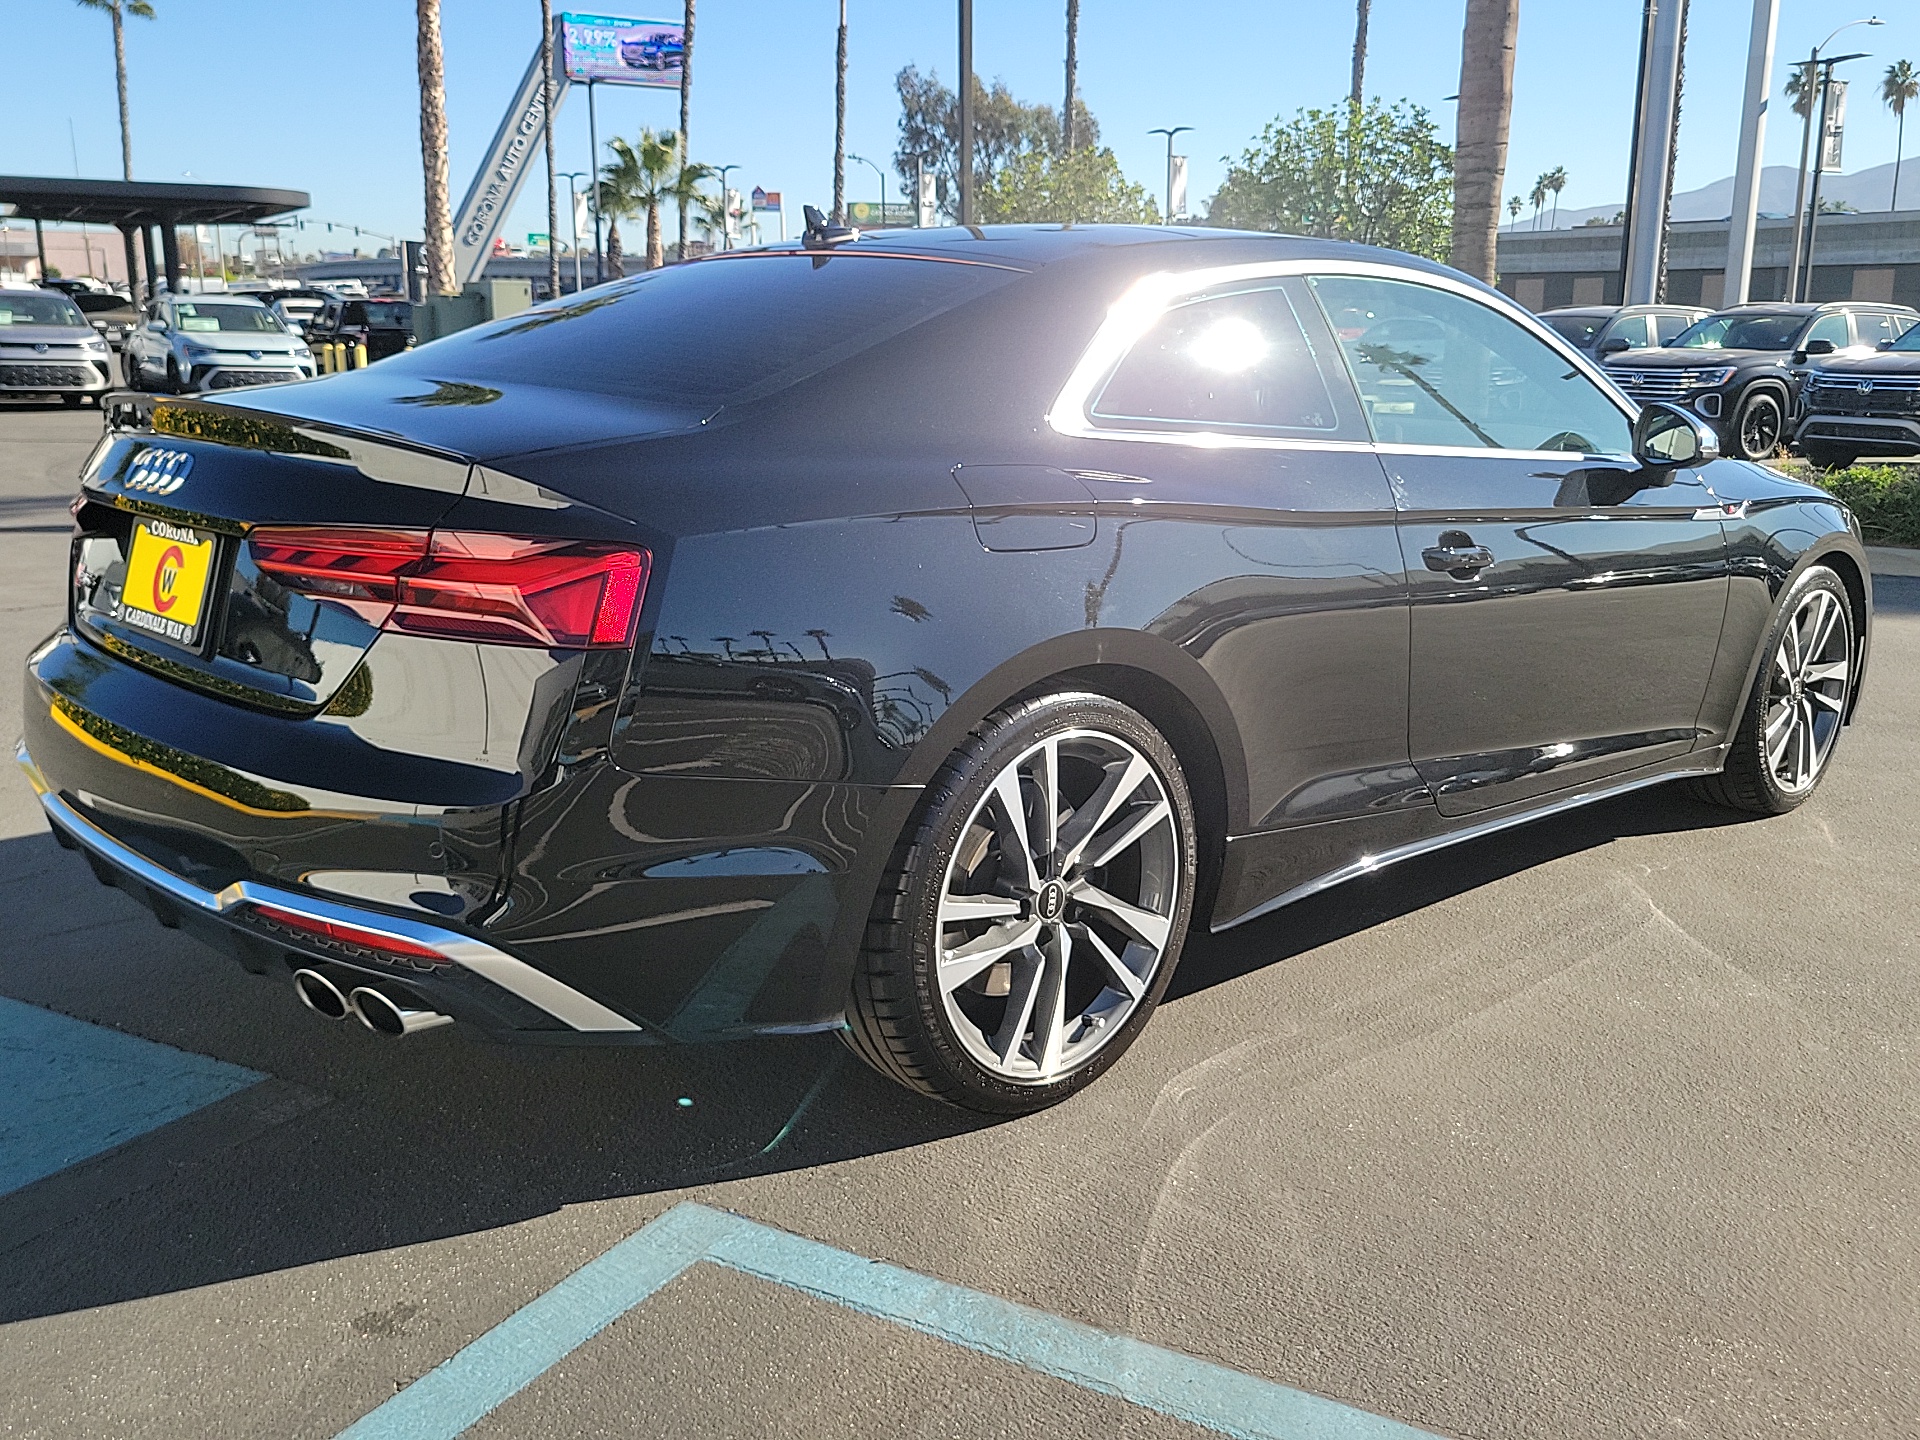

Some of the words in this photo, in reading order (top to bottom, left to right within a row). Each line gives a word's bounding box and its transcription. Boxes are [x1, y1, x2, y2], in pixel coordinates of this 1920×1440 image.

[466, 182, 508, 246] CORONA
[496, 136, 528, 184] AUTO
[151, 520, 195, 544] CORONA
[125, 608, 167, 634] CARDINALE
[166, 619, 185, 641] WAY
